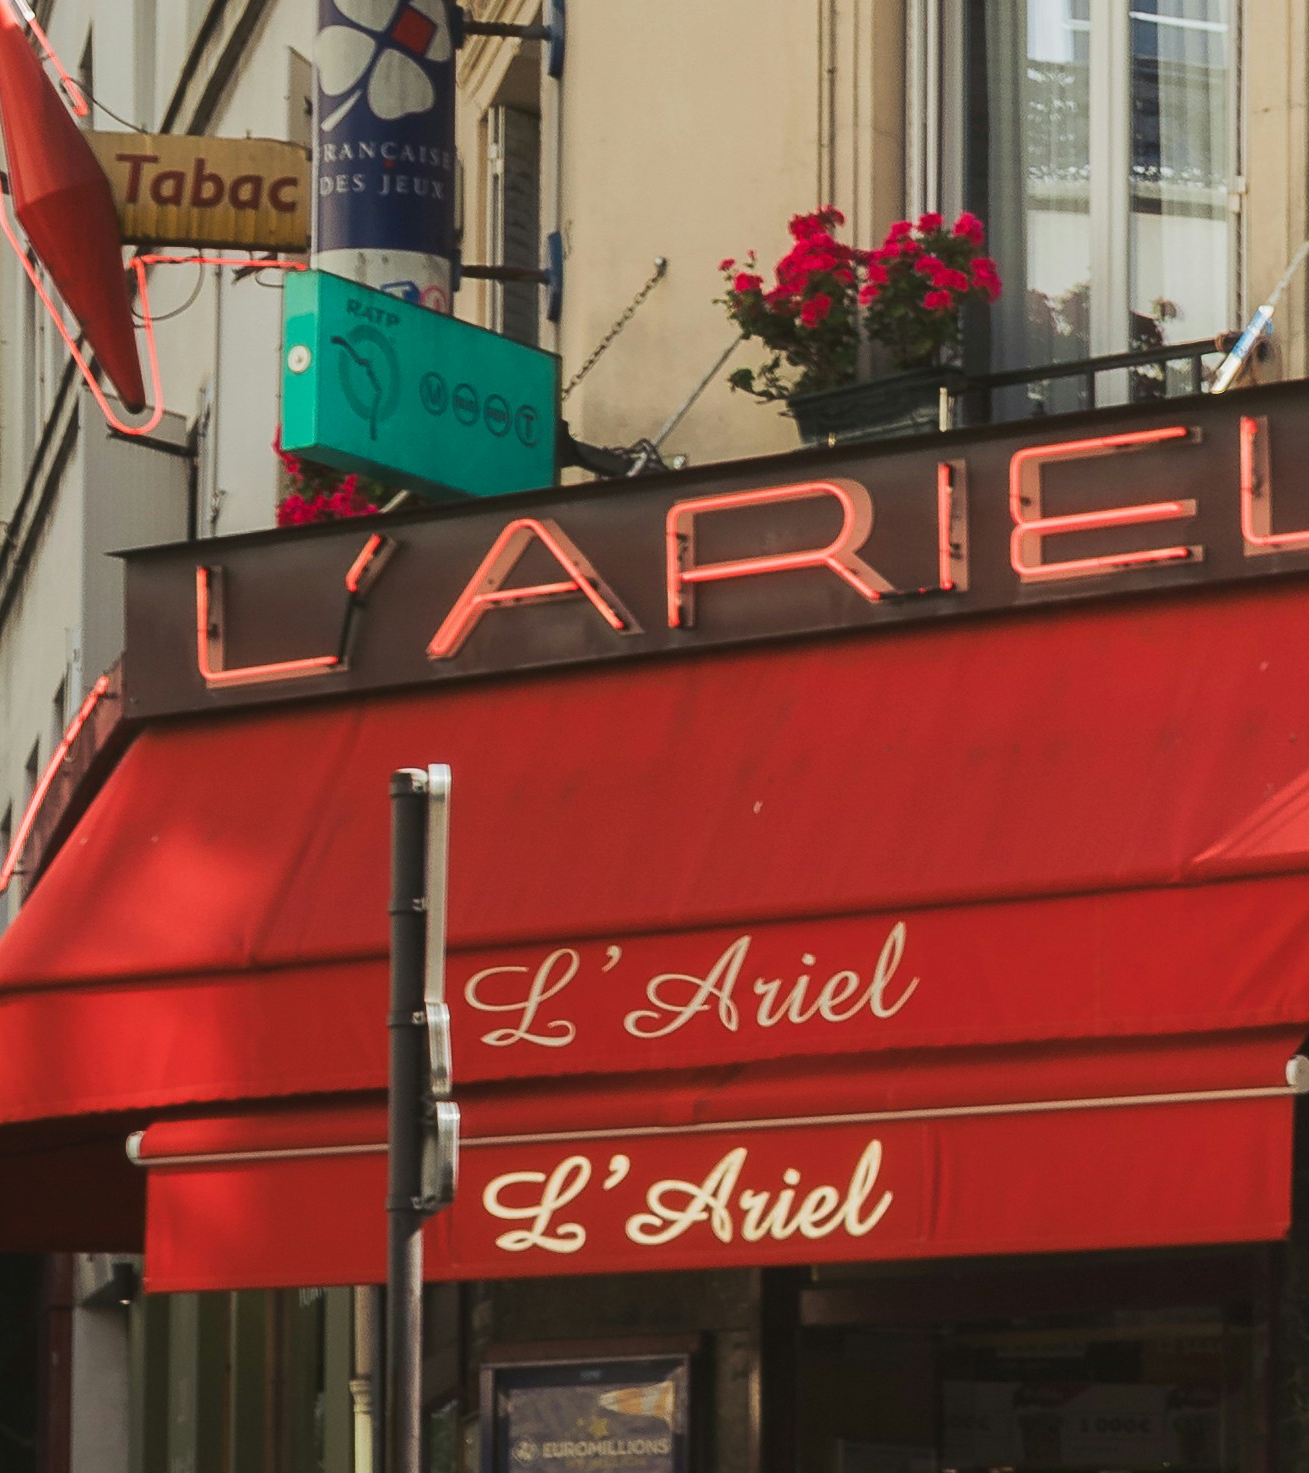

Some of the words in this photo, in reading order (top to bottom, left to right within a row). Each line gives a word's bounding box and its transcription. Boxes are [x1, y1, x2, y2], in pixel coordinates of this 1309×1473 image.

[322, 140, 452, 170] RANÇAISE
[115, 152, 299, 214] Tabac
[319, 173, 366, 197] DES
[378, 174, 445, 200] JEUX
[347, 298, 402, 327] RATP
[464, 921, 920, 1047] L'Ariel
[481, 1139, 893, 1253] L'Ariel
[541, 1437, 671, 1459] EUROMILLIONS
